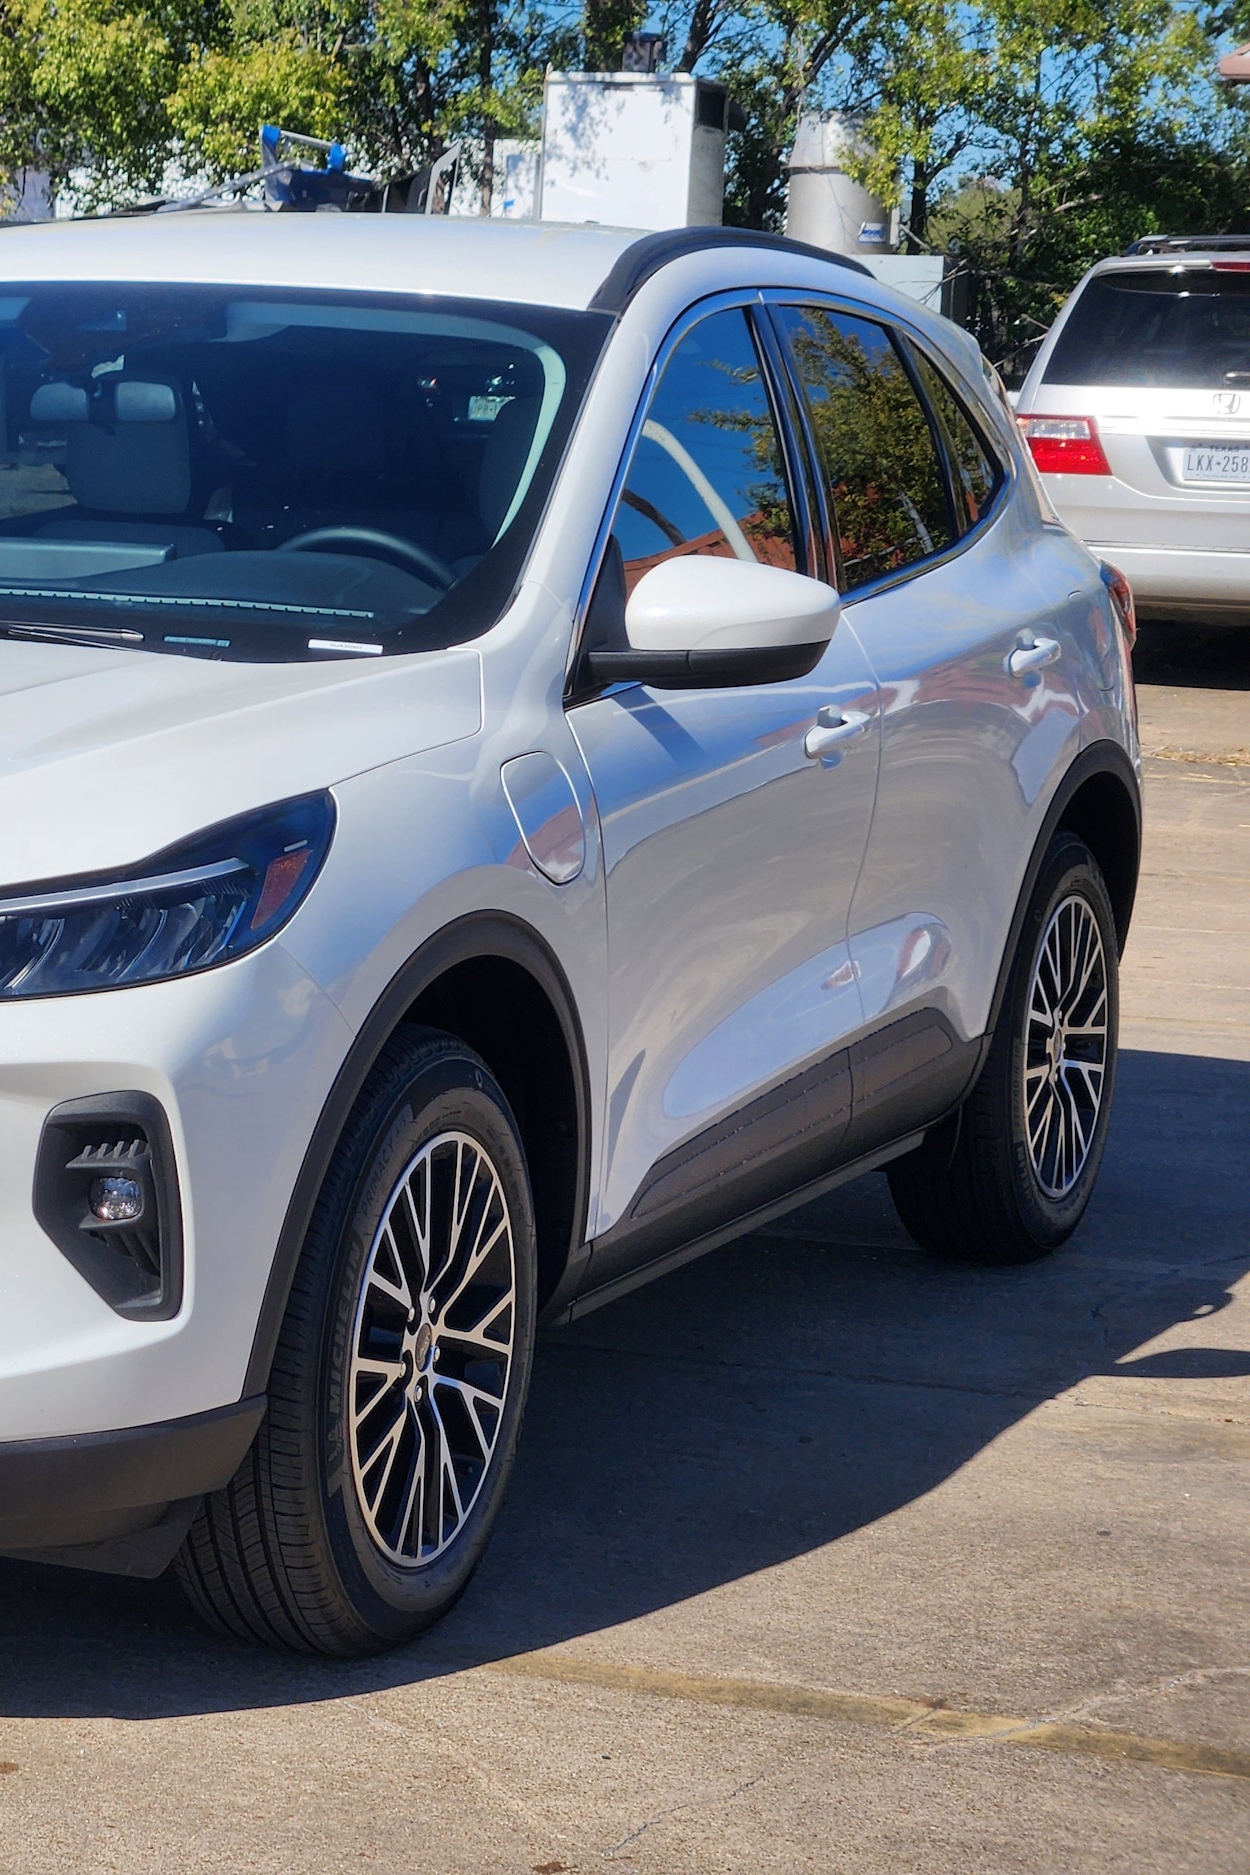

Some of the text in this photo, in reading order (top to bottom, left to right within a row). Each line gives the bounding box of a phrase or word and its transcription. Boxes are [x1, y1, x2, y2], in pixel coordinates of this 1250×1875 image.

[1187, 454, 1250, 473] LKX-258
[362, 1141, 395, 1218] PRIMACY
[328, 1238, 362, 1413] MICHELIN
